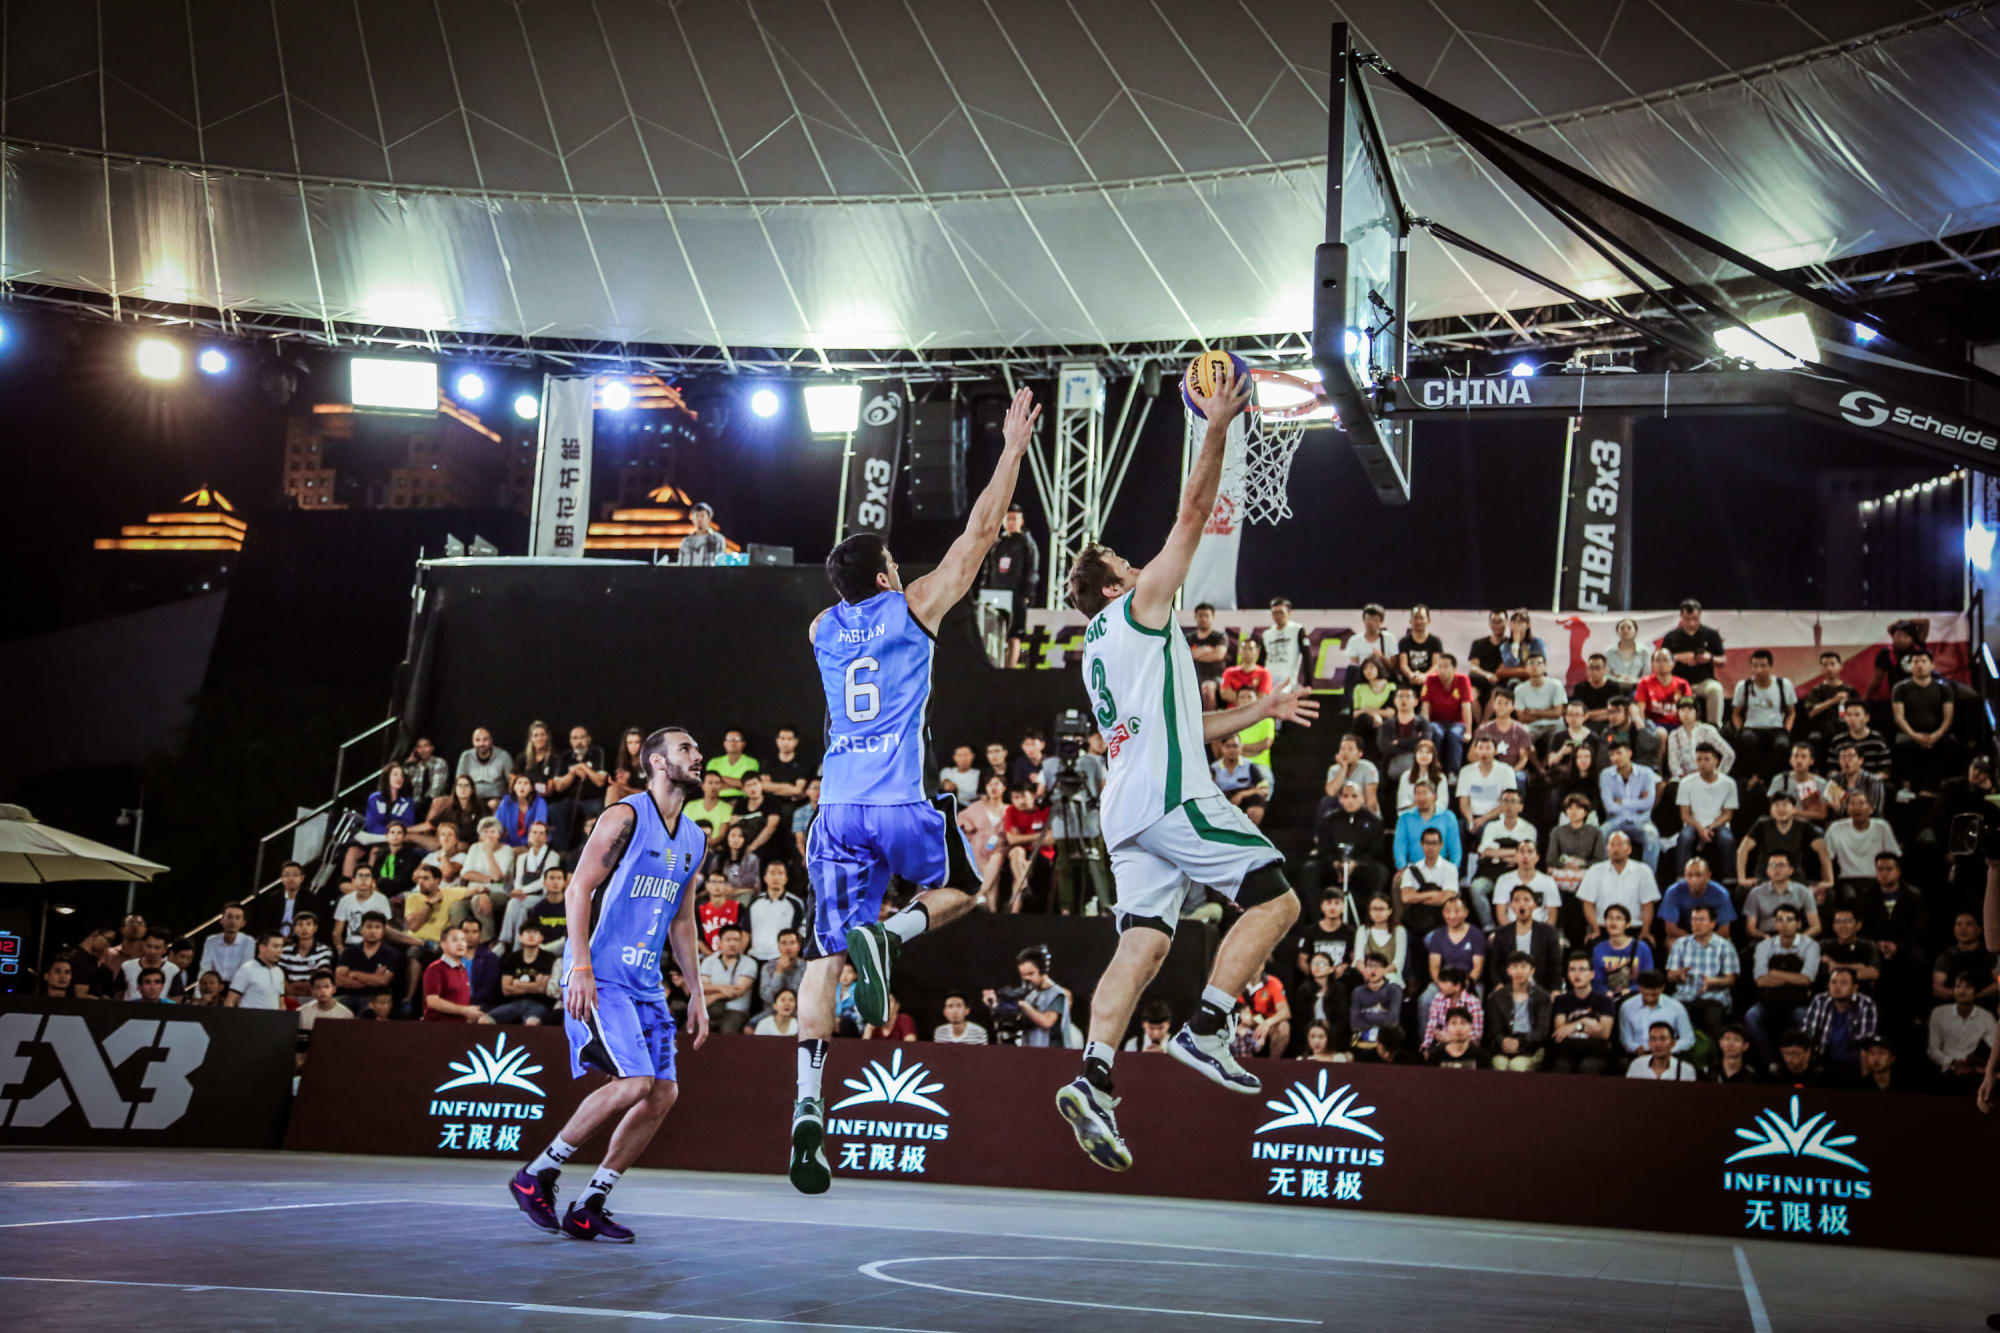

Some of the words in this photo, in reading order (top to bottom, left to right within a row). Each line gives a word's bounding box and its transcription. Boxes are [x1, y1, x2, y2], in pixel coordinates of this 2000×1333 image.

[1423, 379, 1531, 406] CHINA
[1891, 406, 1999, 451] Schelde
[1578, 523, 1616, 614] FIBA
[838, 623, 886, 644] FABIAN
[844, 655, 881, 723] 6
[1091, 657, 1117, 728] 3
[429, 1100, 545, 1120] INFINITUS
[438, 1123, 522, 1152] 无限极
[826, 1118, 949, 1140] INFINITUS
[838, 1143, 926, 1173] 无限极
[1252, 1141, 1385, 1167] INFINITUS
[1267, 1167, 1362, 1201] 无限极
[1723, 1171, 1873, 1199] INFINITUS
[1744, 1199, 1851, 1236] 无限极
